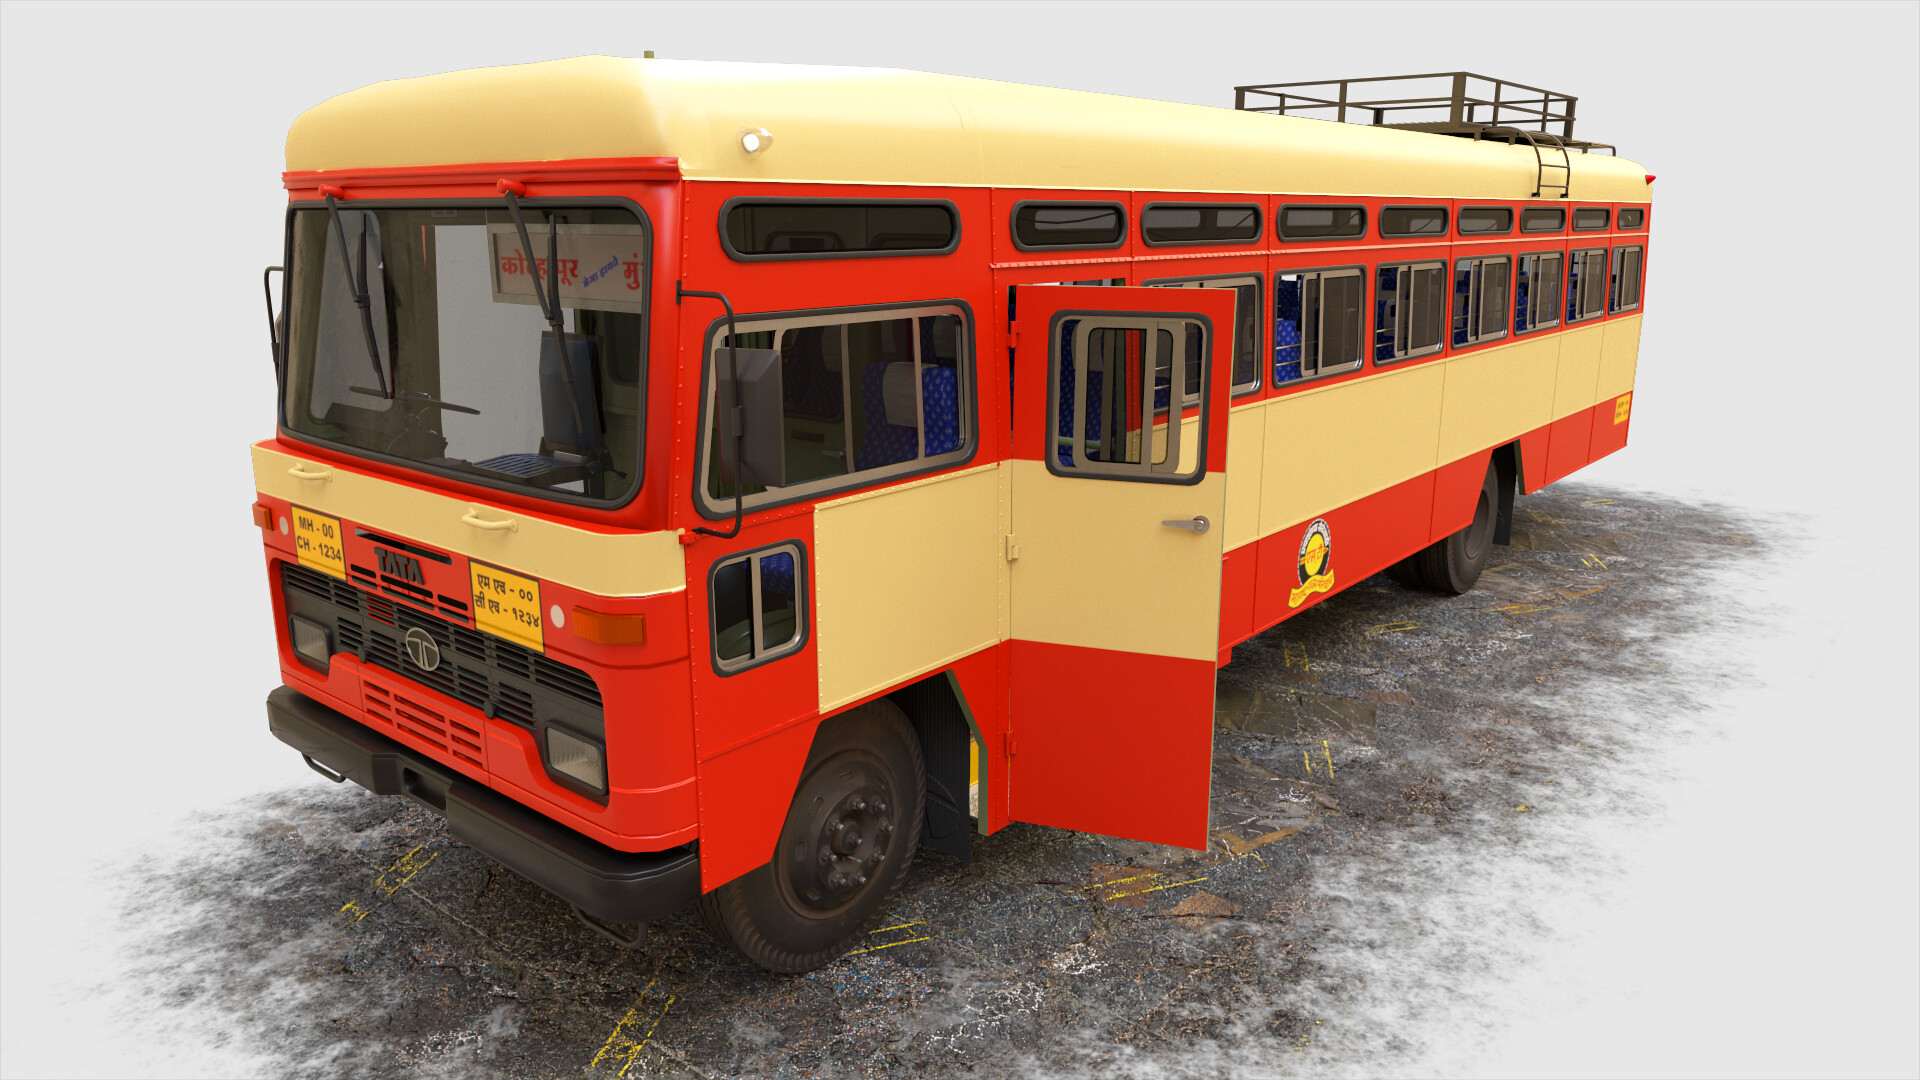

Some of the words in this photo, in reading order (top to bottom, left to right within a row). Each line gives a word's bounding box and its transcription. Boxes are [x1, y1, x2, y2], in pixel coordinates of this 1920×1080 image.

[298, 516, 314, 533] MH
[322, 523, 334, 539] 00
[296, 535, 311, 552] CH
[318, 542, 342, 562] 1234
[373, 546, 425, 585] TATA
[477, 573, 490, 590] एम
[493, 578, 506, 595] एच
[474, 591, 486, 609] सी
[487, 599, 500, 614] एच
[512, 607, 540, 628] १२३४
